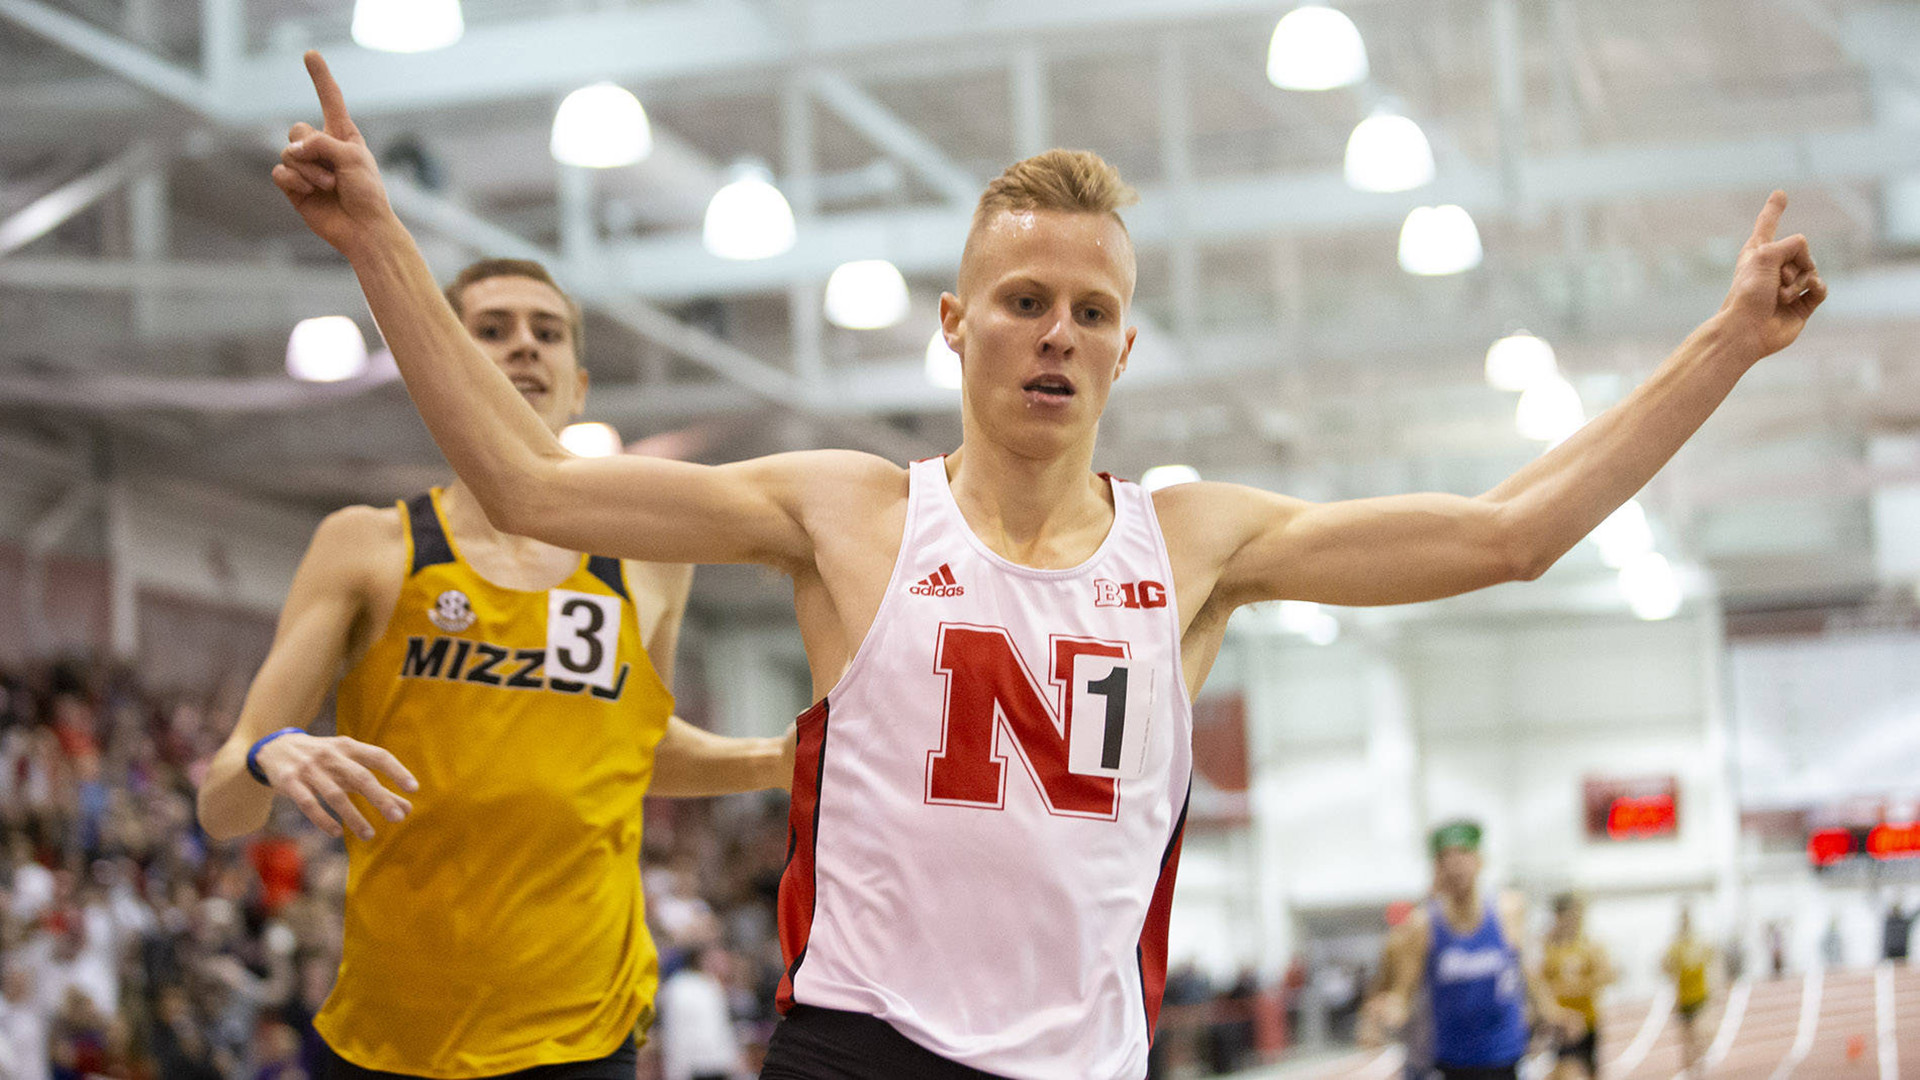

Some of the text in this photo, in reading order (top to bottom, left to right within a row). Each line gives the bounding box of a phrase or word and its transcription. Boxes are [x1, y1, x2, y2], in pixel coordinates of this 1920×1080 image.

[909, 585, 965, 598] adidas
[401, 635, 631, 702] MIZZU
[556, 598, 605, 674] 3
[924, 621, 1132, 822] N
[1087, 666, 1129, 770] 1
